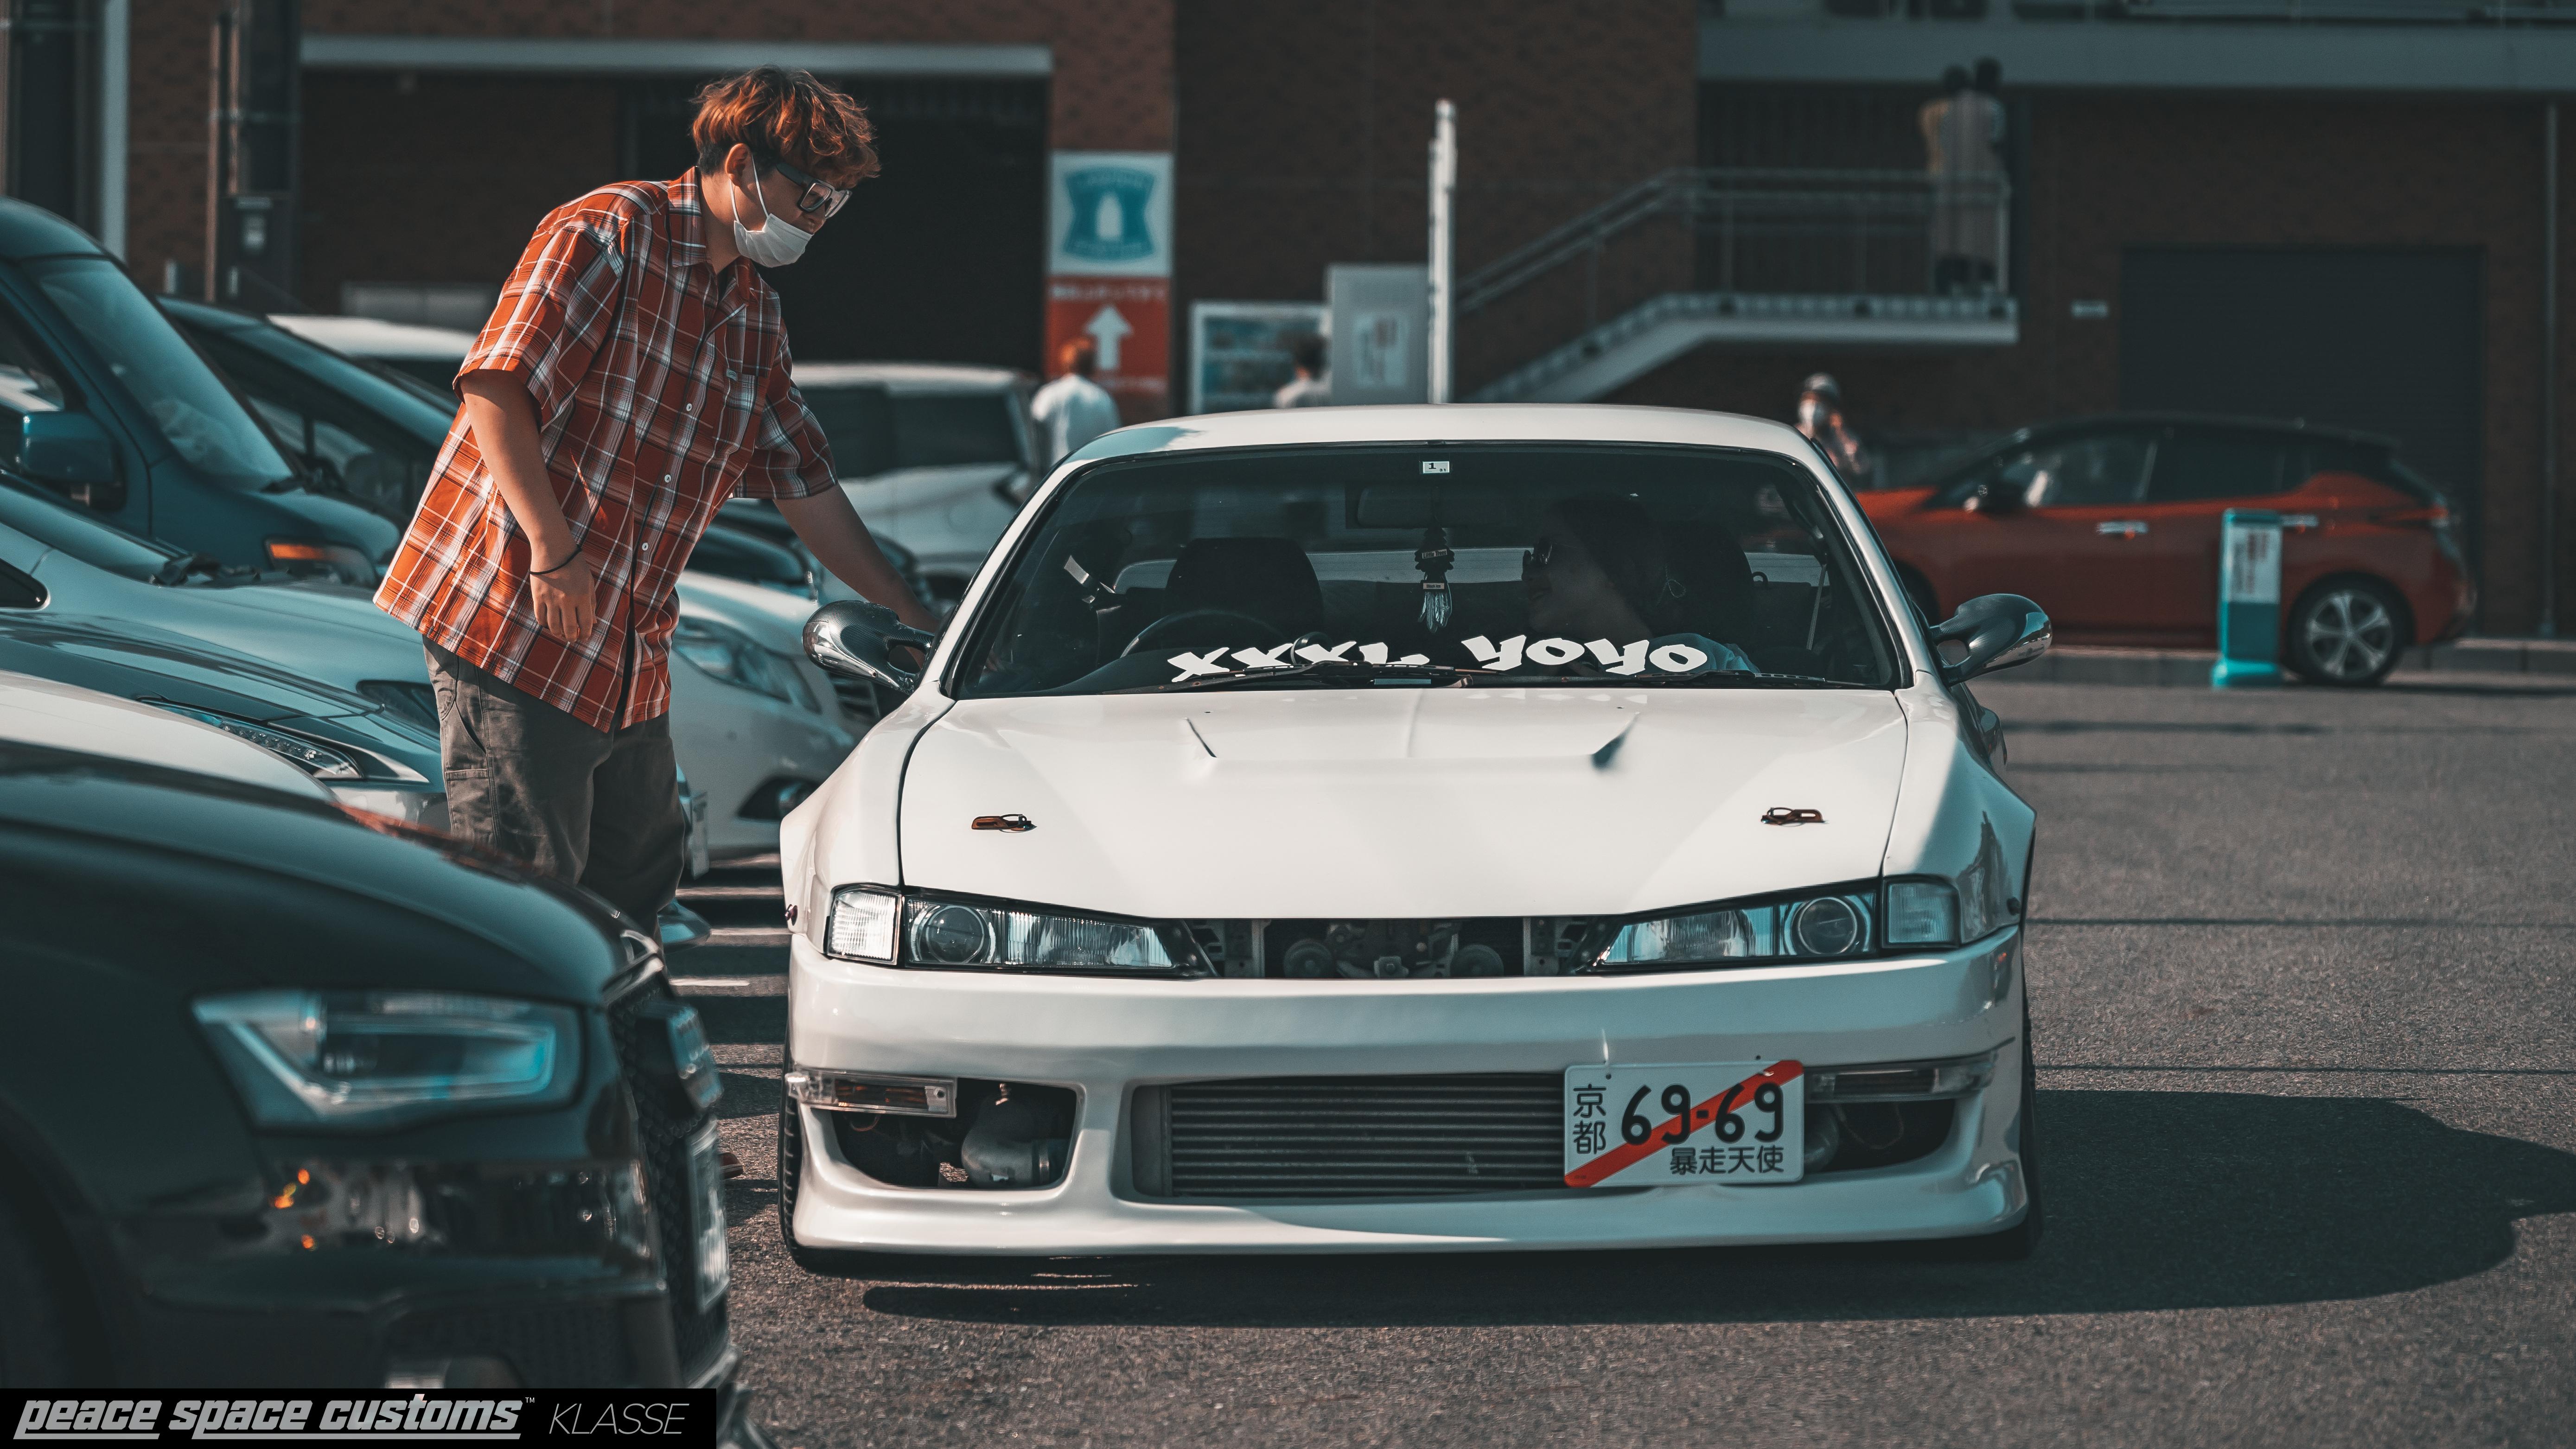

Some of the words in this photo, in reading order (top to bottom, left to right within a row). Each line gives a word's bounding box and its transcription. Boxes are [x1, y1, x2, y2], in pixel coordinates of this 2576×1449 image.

[1573, 1084, 1607, 1155] 京都
[1670, 1145, 1784, 1175] 暴走天使
